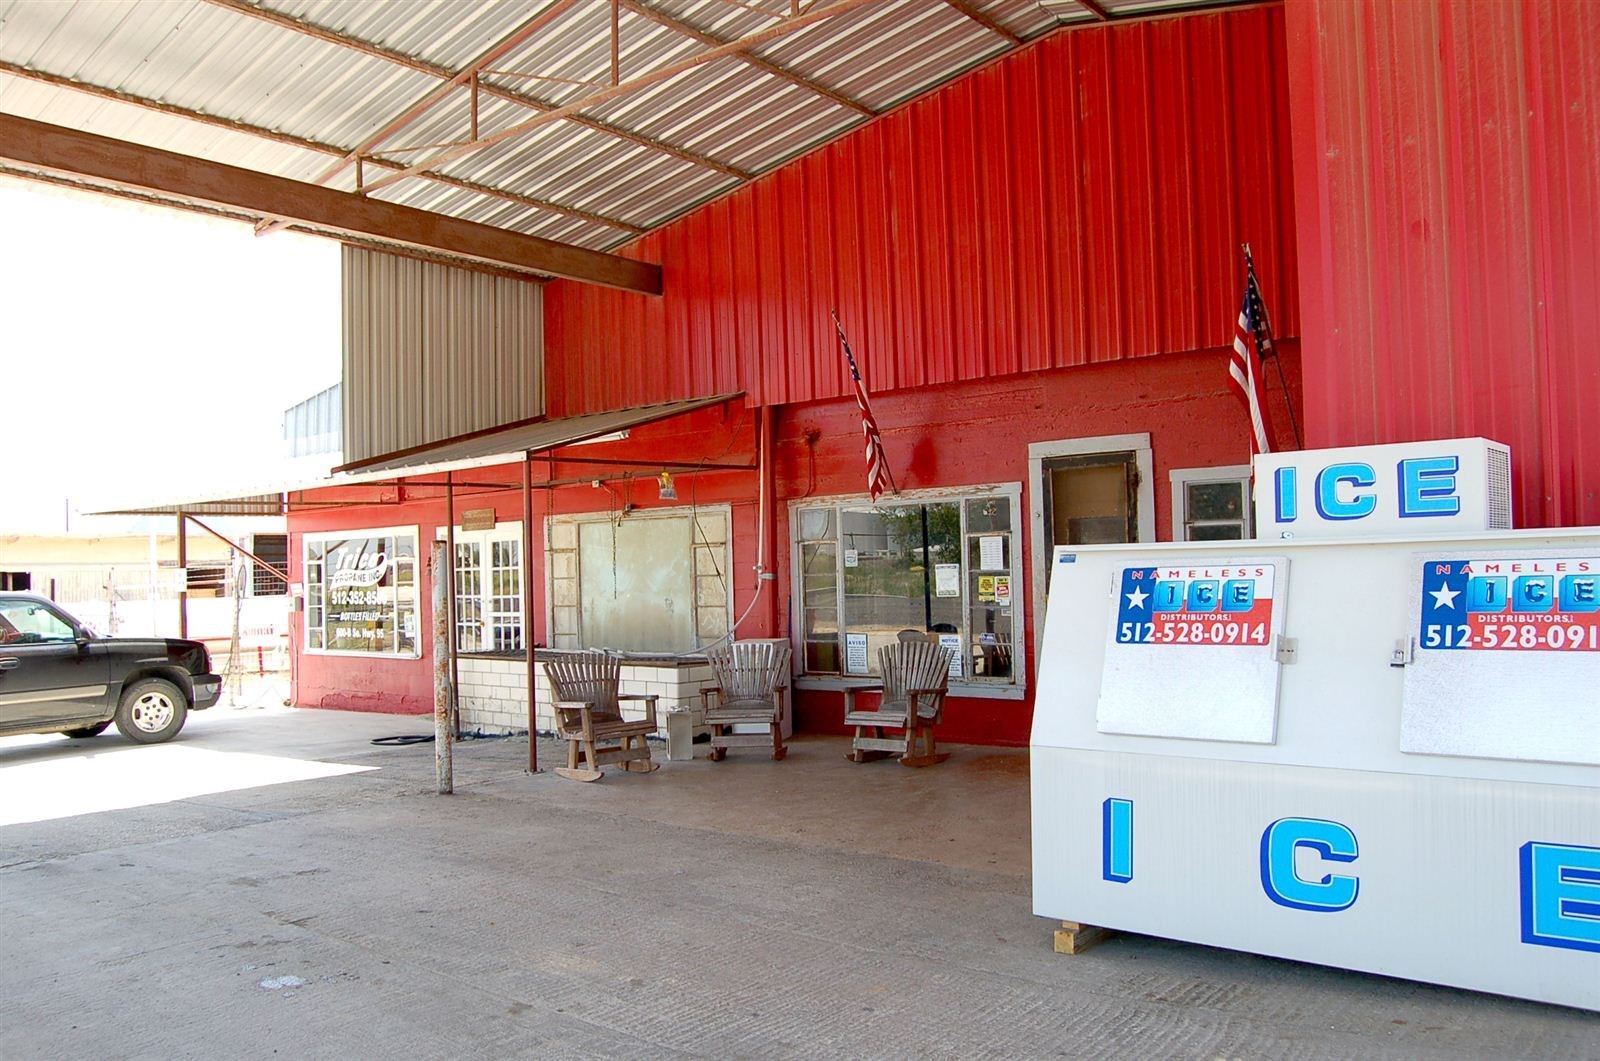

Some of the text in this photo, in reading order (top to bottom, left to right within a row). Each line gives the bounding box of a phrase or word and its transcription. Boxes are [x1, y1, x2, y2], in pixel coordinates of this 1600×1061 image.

[1274, 456, 1461, 523] ICE
[335, 546, 380, 569] Trico
[1435, 562, 1590, 575] NAMELES
[335, 572, 367, 583] PROPANE
[1131, 568, 1264, 580] NAMELESS
[1166, 581, 1251, 605] ICE
[1483, 577, 1597, 605] ICE
[1120, 622, 1265, 644] 512-528-0914
[1425, 624, 1598, 649] 512-528-091
[1103, 797, 1600, 954] ICE
